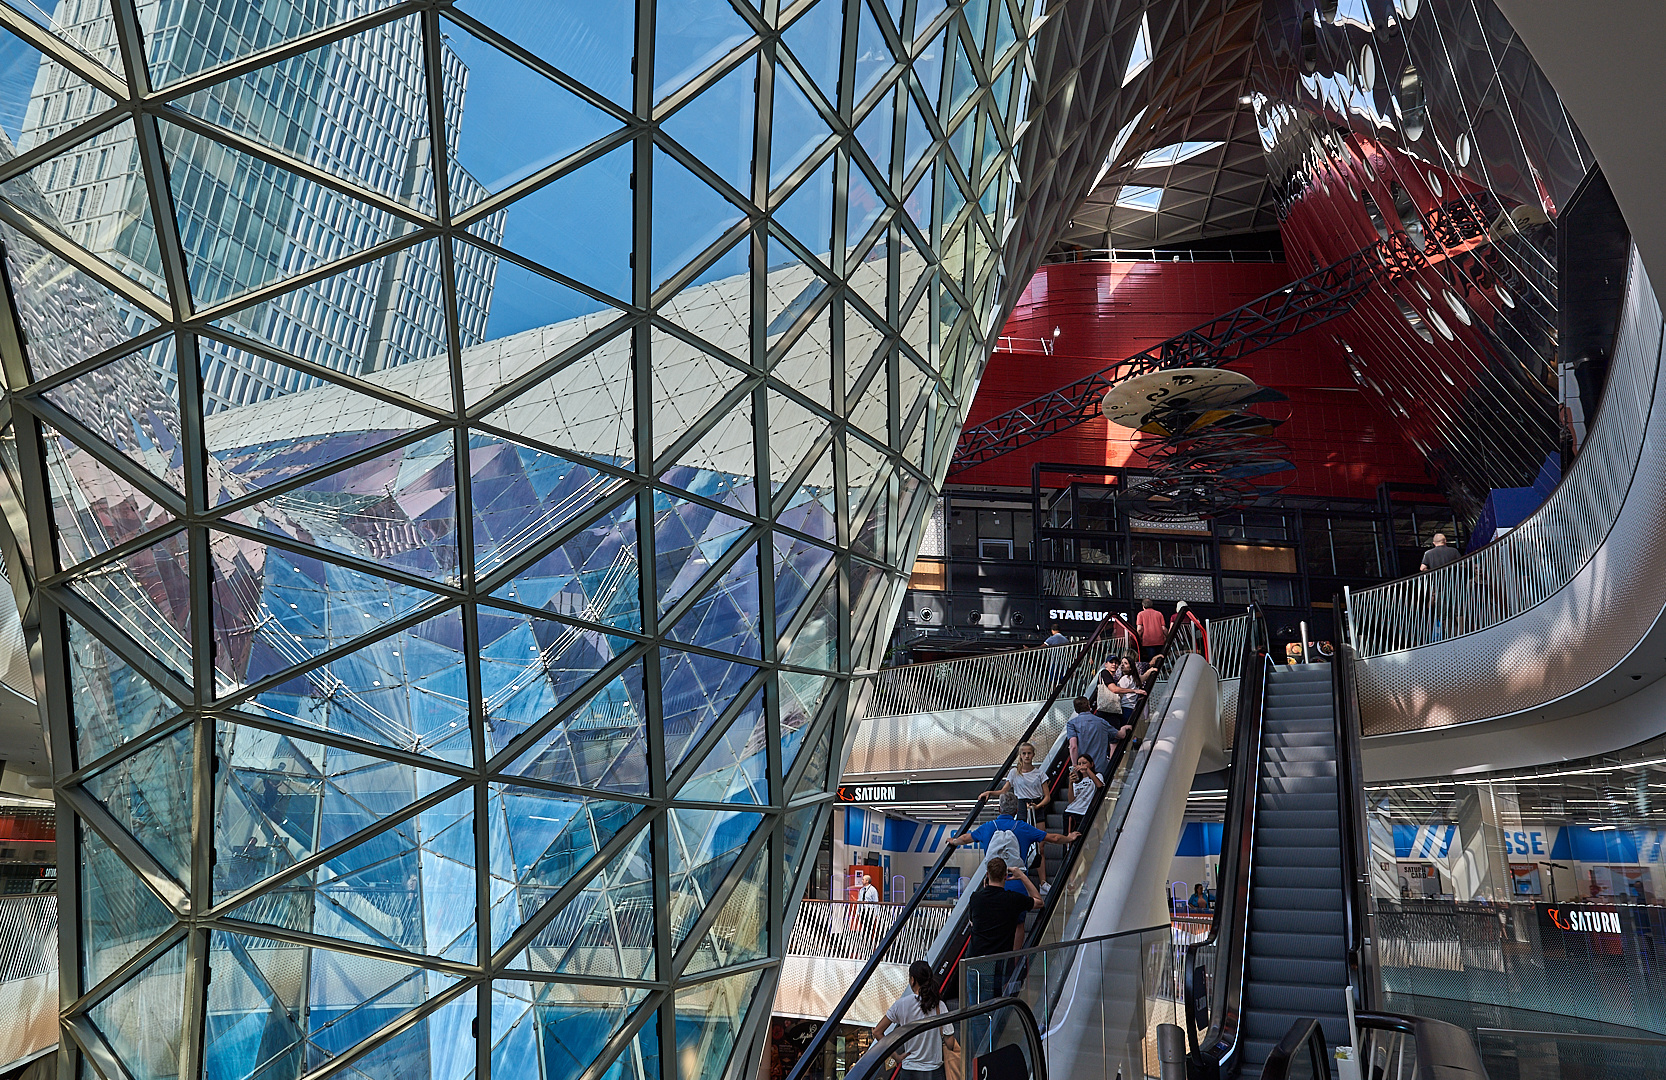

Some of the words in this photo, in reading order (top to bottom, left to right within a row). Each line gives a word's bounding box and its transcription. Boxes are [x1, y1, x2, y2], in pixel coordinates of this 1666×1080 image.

[1049, 609, 1128, 622] STARBUCS
[854, 786, 896, 801] SATURN
[1569, 910, 1621, 934] SATURN
